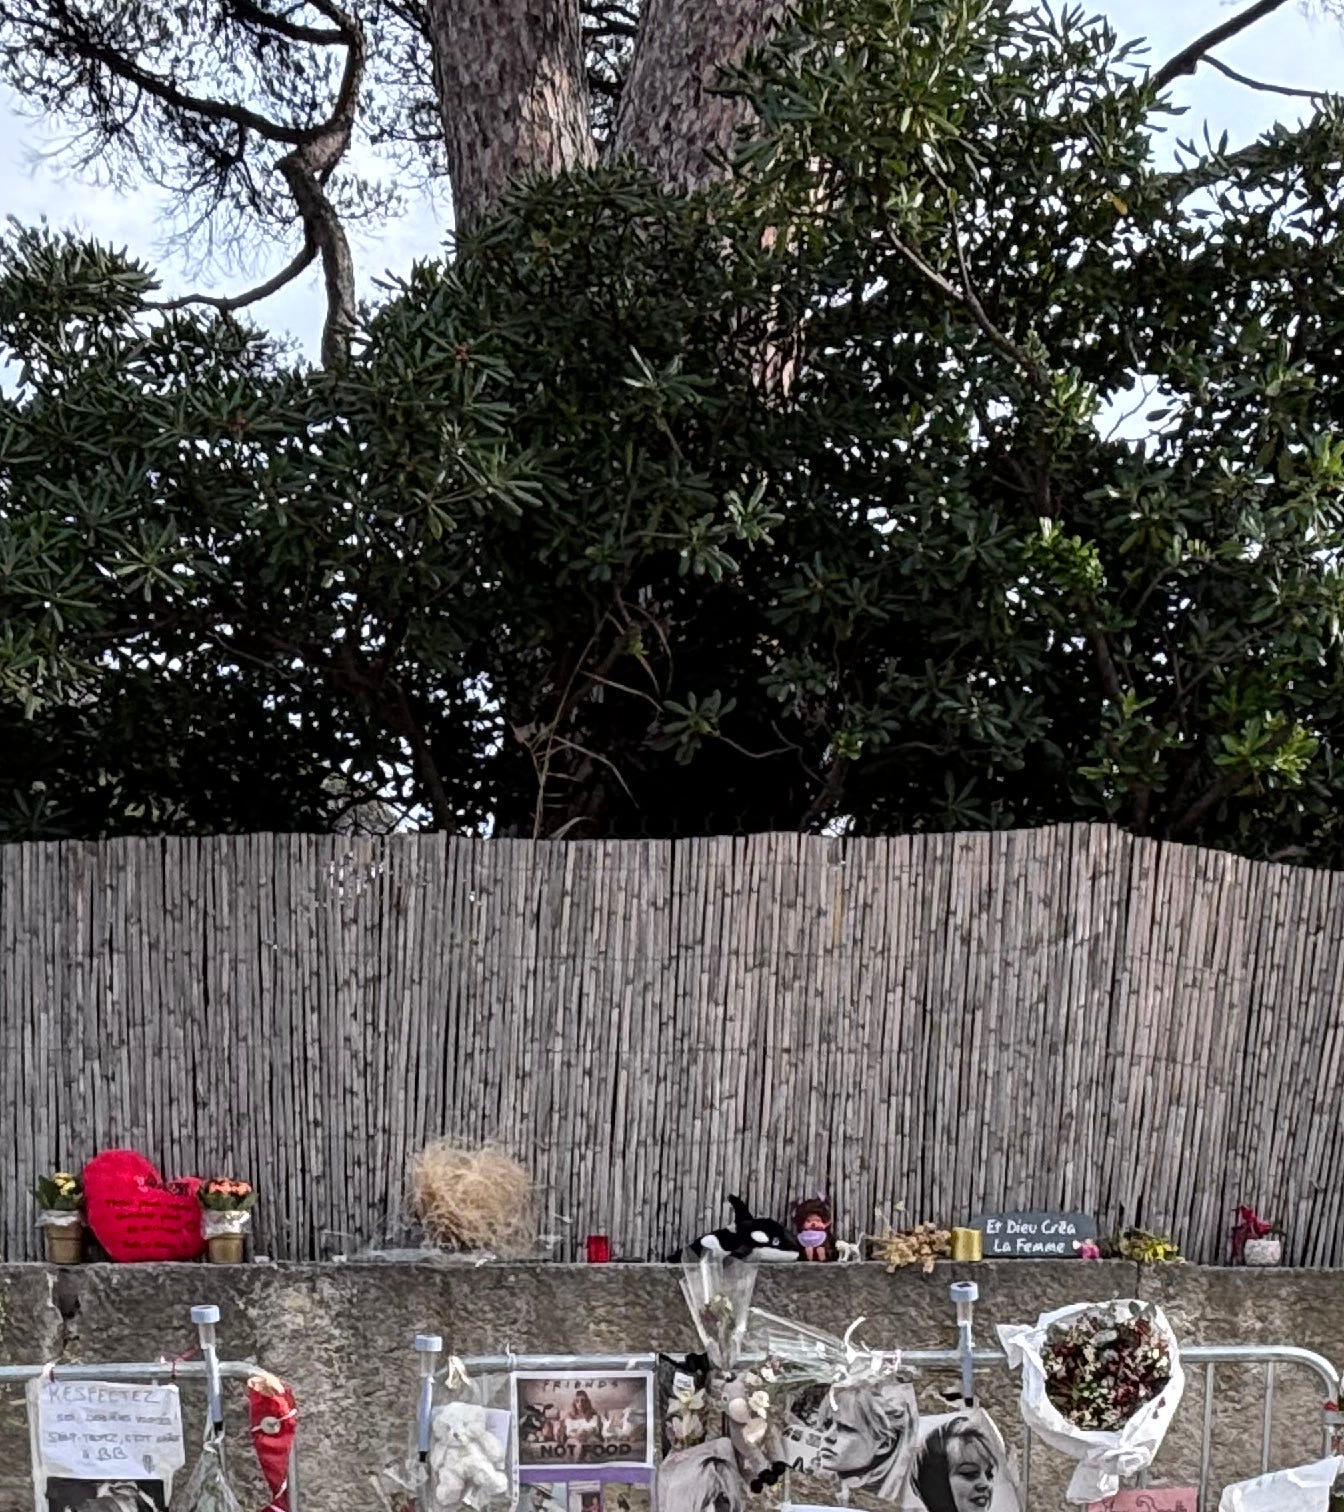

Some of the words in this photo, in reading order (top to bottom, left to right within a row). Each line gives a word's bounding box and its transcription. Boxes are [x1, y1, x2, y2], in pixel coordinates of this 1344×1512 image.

[986, 1219, 1003, 1234] Et
[1006, 1219, 1038, 1234] Dieu
[993, 1239, 1012, 1253] La
[1016, 1238, 1066, 1254] Femme
[48, 1384, 161, 1404] RESPECTEZ
[540, 1444, 577, 1458] NOT
[580, 1443, 633, 1458] FOOD
